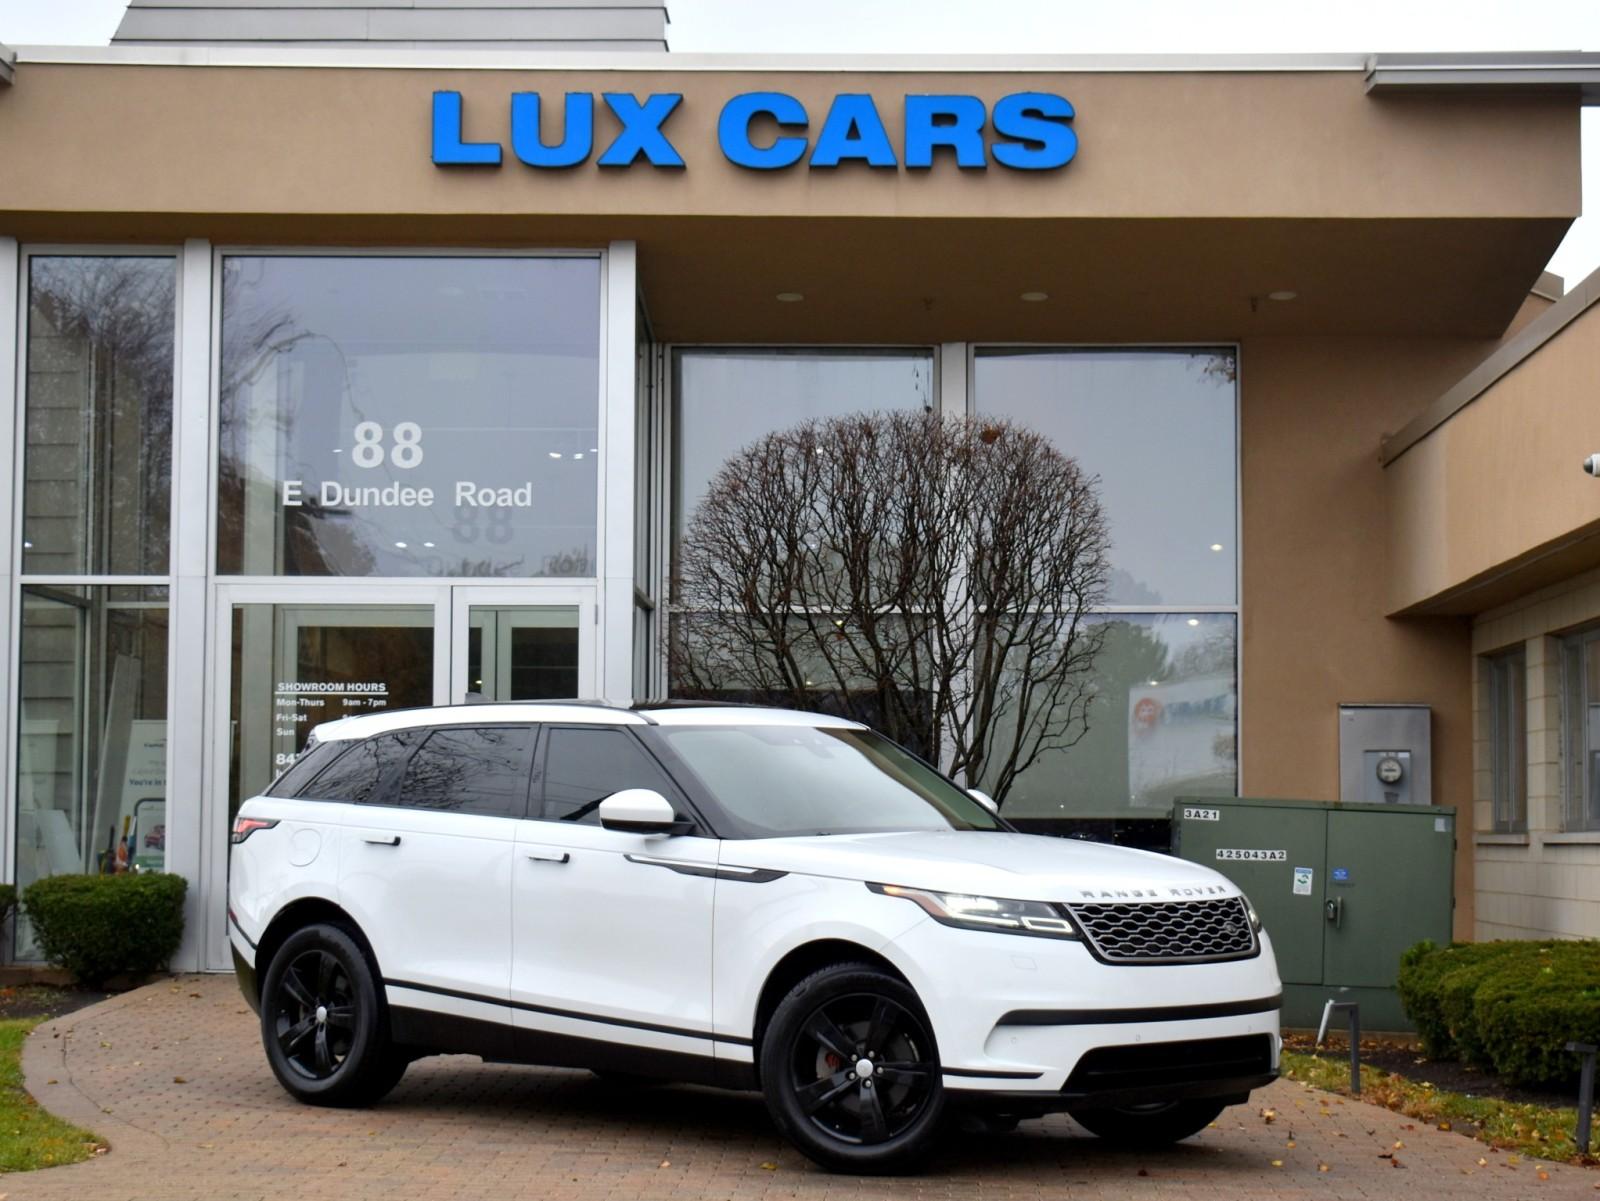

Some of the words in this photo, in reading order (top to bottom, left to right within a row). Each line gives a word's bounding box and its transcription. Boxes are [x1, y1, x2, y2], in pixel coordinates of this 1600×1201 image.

[431, 90, 686, 168] LUX
[717, 91, 1079, 170] CARS
[351, 421, 423, 468] 88
[282, 480, 303, 506] E
[320, 481, 434, 507] Dundee
[455, 482, 533, 507] Road
[278, 682, 345, 692] SHOWROOM
[346, 682, 386, 692] HOURS
[276, 697, 325, 707] Mon-Thurs
[342, 698, 361, 706] 9am
[367, 698, 387, 708] 7pm
[276, 713, 308, 722] Fri-Sat
[276, 727, 295, 736] Sun
[1184, 809, 1218, 819] 3A21
[1217, 850, 1285, 860] 425043A2
[1080, 889, 1158, 898] RANGE
[1169, 885, 1226, 897] ROVER
